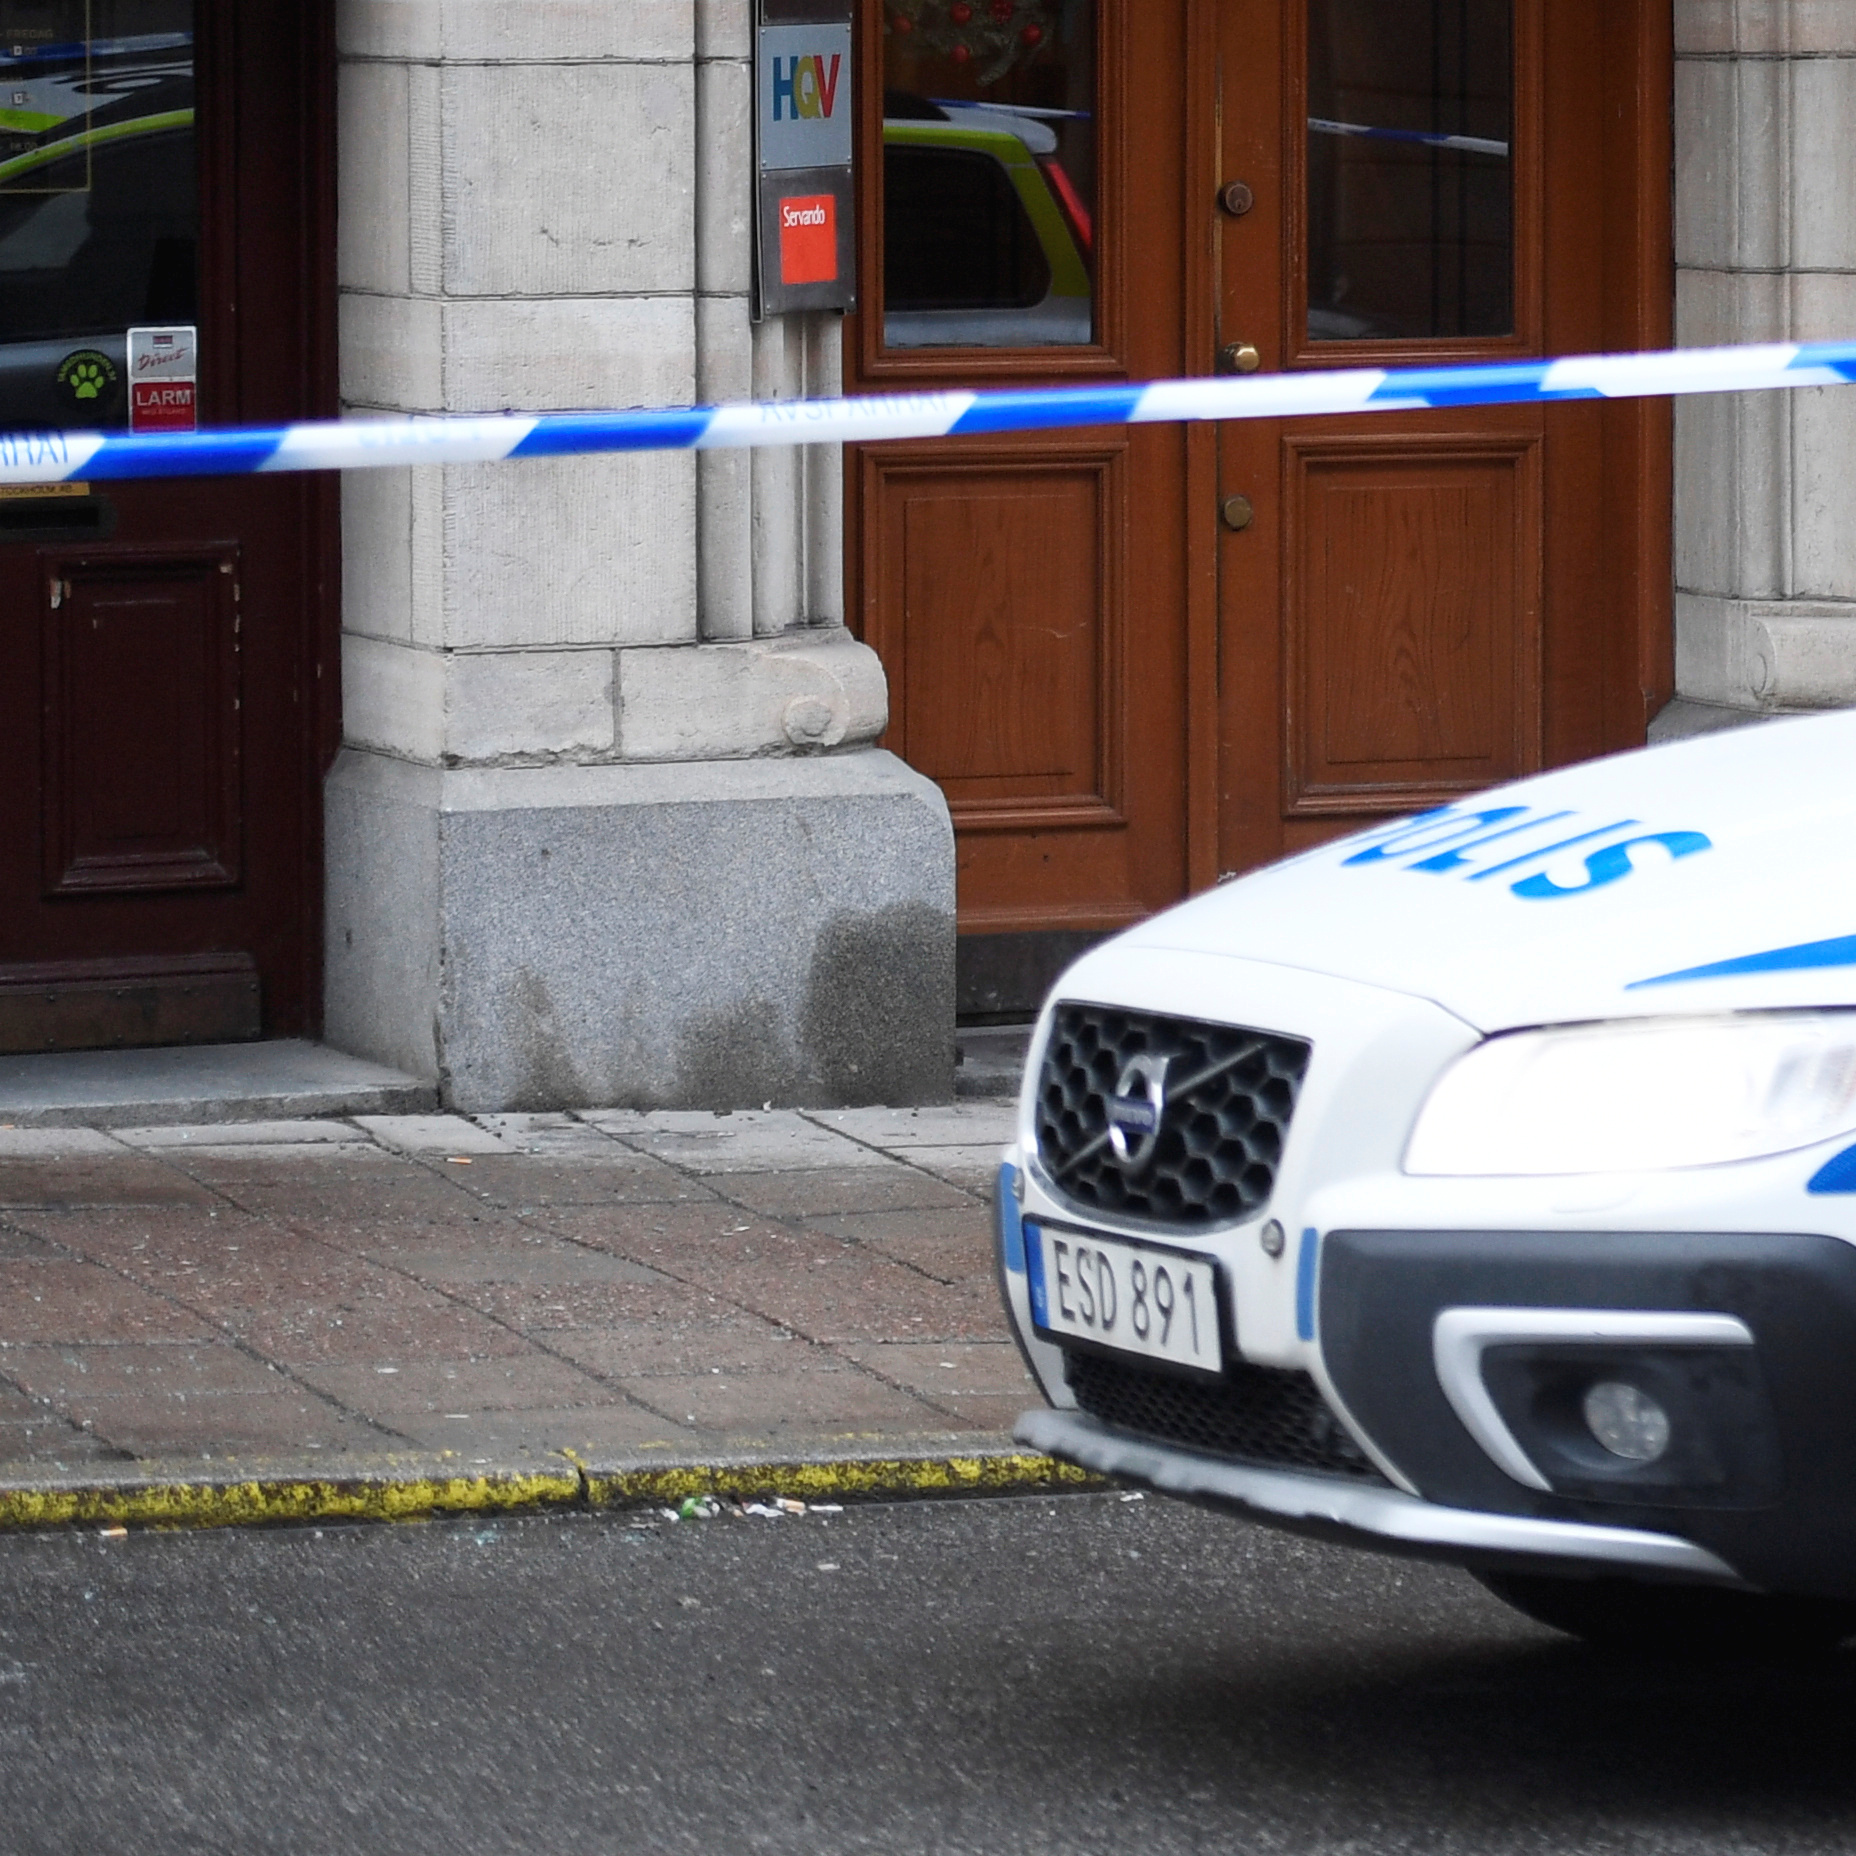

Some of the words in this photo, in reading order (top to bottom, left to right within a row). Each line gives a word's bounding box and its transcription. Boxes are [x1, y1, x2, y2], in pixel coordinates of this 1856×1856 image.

[772, 53, 841, 122] HQV
[783, 204, 826, 228] Servando
[136, 390, 192, 406] LARM
[1337, 805, 1714, 902] OLIS
[1053, 1239, 1118, 1331] ESD
[1131, 1258, 1200, 1356] 891
